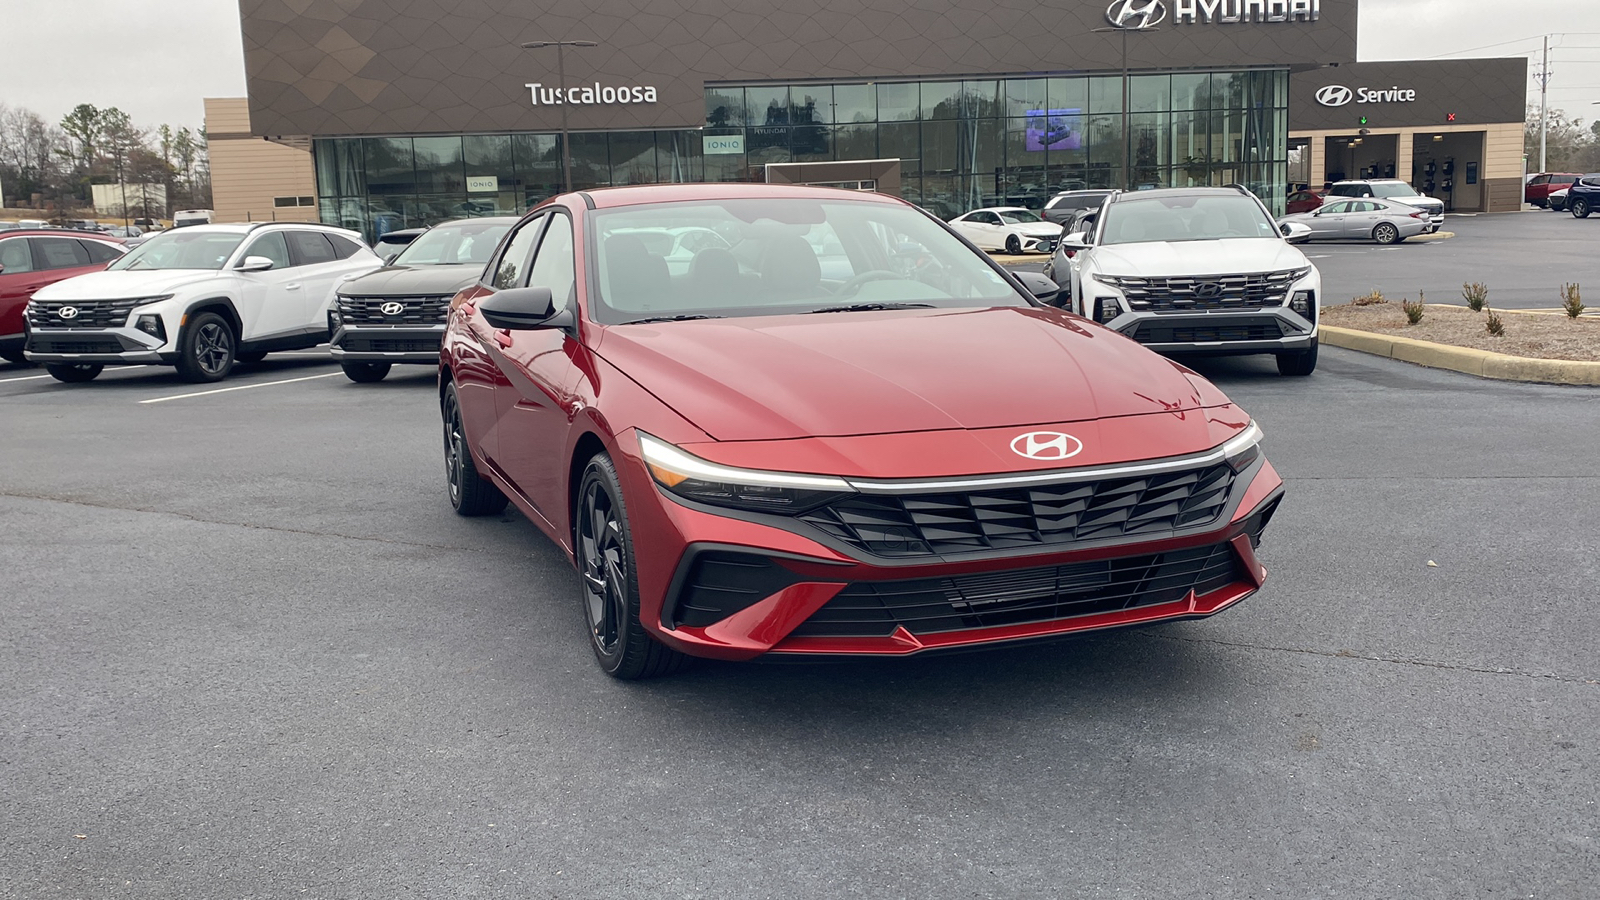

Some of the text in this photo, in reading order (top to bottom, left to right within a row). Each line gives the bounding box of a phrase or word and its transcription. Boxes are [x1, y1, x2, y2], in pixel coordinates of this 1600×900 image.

[1174, 0, 1320, 23] HYUNDAI
[525, 82, 657, 105] Tuscaloosa
[1356, 86, 1416, 103] Service
[708, 141, 739, 149] IONIQ
